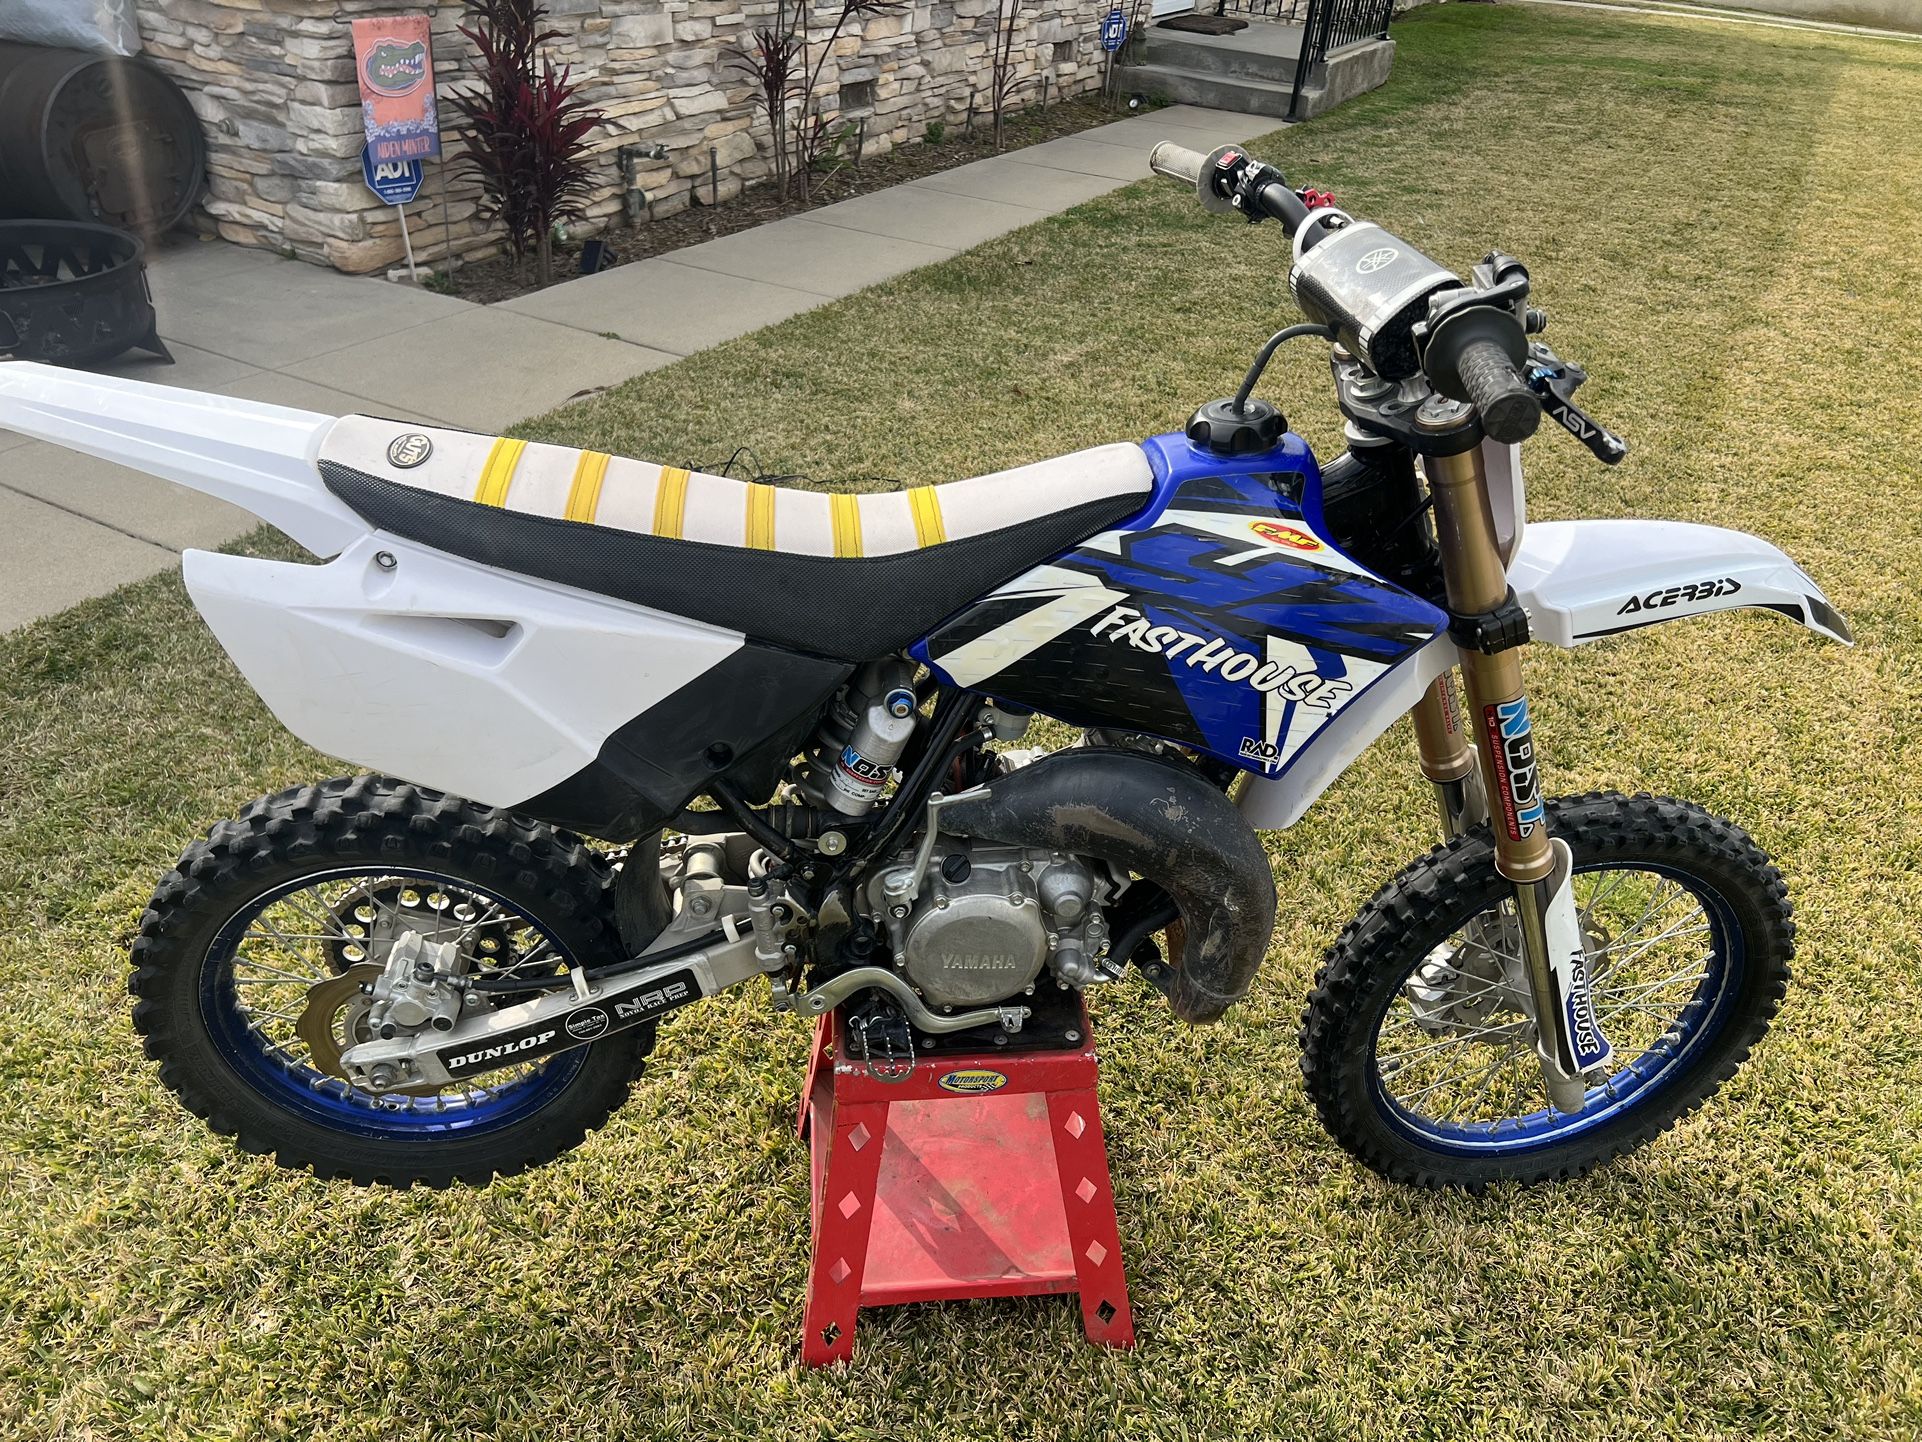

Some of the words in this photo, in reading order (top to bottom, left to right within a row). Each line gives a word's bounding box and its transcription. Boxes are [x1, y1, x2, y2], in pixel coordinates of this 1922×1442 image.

[1552, 406, 1596, 439] ASV
[1252, 524, 1319, 547] FMF
[1090, 605, 1353, 710] FASTHOUSE
[1492, 734, 1506, 783] SUSPENSION
[1501, 785, 1516, 835] COMPONENTS
[941, 952, 1016, 969] YAMAHA
[614, 981, 687, 1014] NRP
[669, 990, 689, 1001] PREP
[1570, 948, 1600, 1056] FASTHOUSE
[448, 1029, 556, 1069] DUNLOP
[946, 1075, 999, 1085] MOTORSPORT
